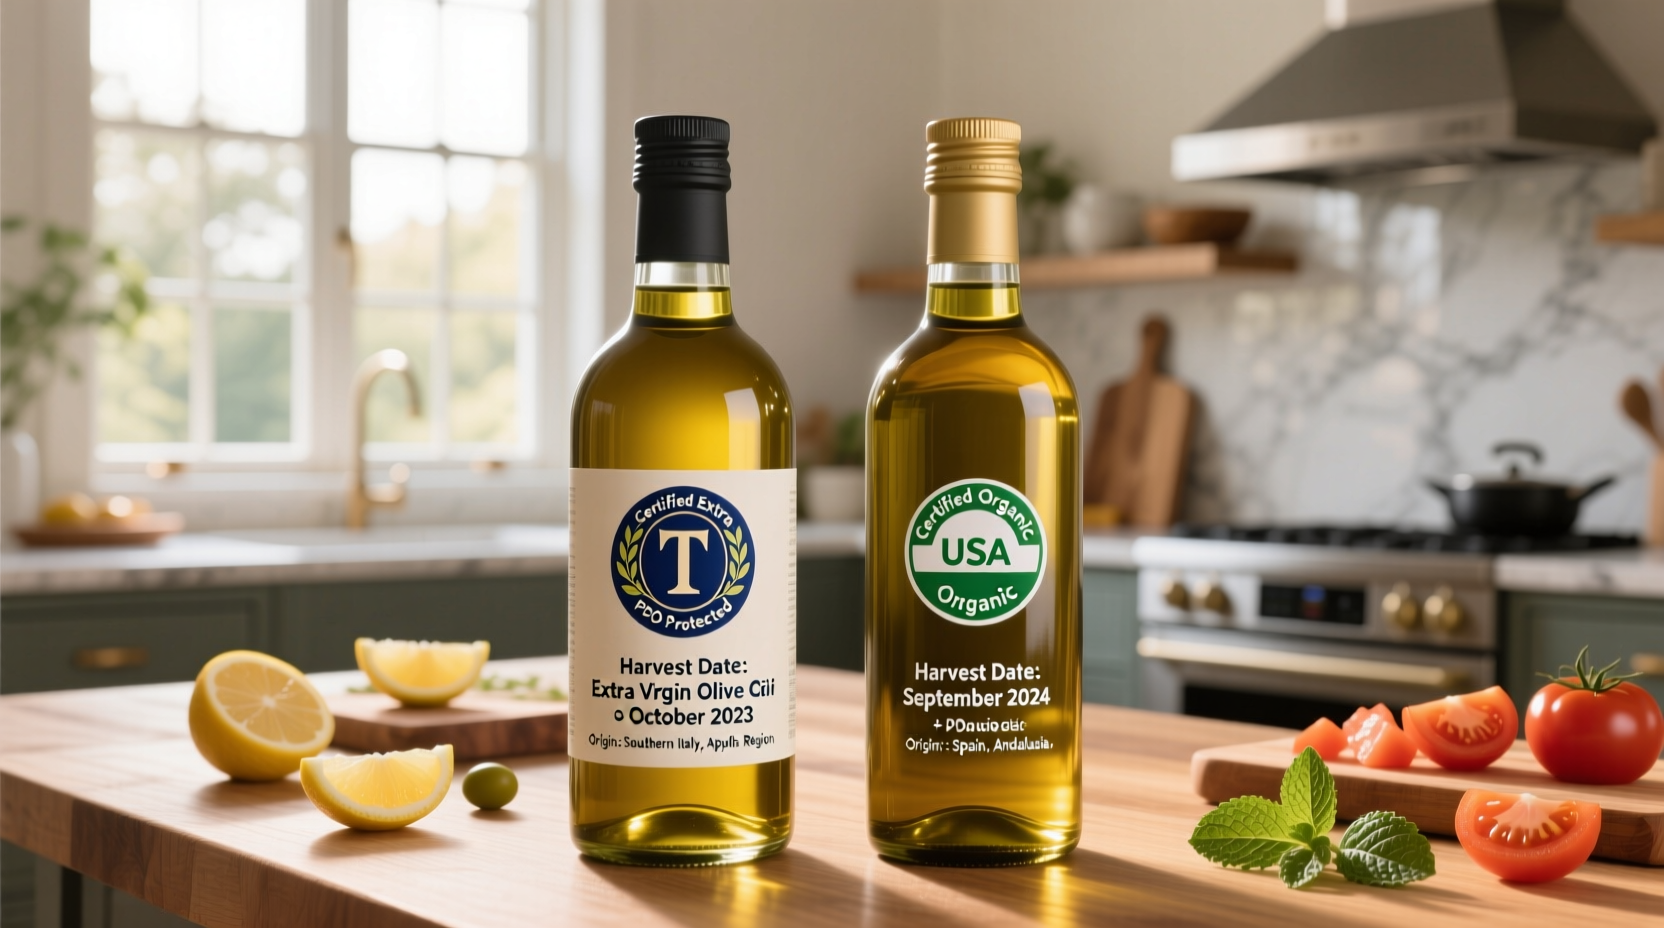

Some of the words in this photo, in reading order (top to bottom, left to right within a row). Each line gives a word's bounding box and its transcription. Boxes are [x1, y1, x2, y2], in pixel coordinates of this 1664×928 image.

[635, 493, 694, 523] Certified
[697, 496, 733, 527] Extra
[978, 488, 1034, 541] Organic
[659, 528, 709, 594] T
[941, 537, 1011, 566] USA
[665, 597, 733, 631] Protected
[620, 657, 692, 676] Harvest
[699, 657, 748, 675] Date:
[915, 662, 987, 681] Harvest
[991, 662, 1041, 681] Date:
[592, 678, 635, 700] Extra
[697, 681, 745, 700] Olive
[902, 687, 1004, 712] September
[1006, 687, 1051, 706] 2024
[629, 706, 706, 726] October
[710, 705, 754, 725] 2023
[589, 733, 622, 750] Origin:
[624, 735, 674, 750] Southern
[952, 738, 990, 756] Spain,
